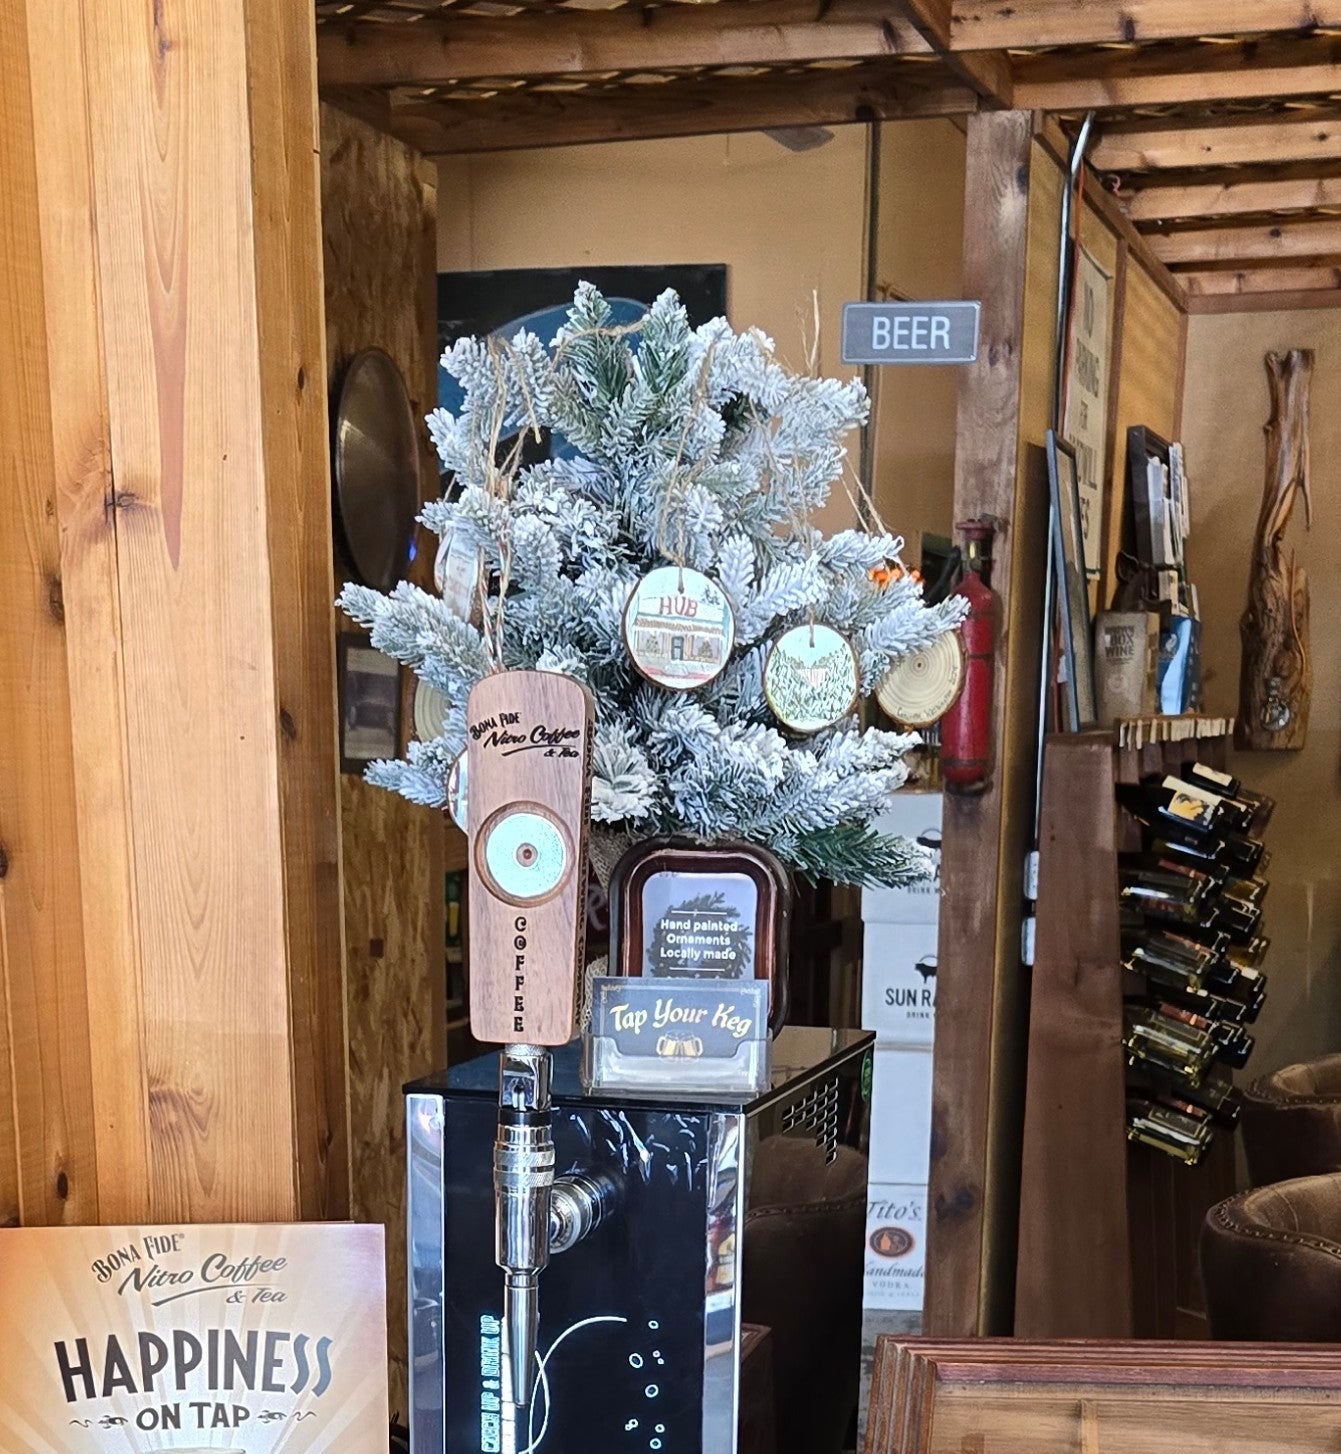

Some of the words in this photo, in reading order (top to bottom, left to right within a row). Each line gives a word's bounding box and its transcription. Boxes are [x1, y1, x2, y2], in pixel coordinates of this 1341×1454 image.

[872, 315, 951, 350] BEER
[659, 595, 698, 618] HUB
[1105, 647, 1134, 657] WINE
[470, 718, 497, 740] BONA
[483, 731, 526, 748] Nitro
[530, 725, 580, 744] Coffee
[544, 749, 554, 757] &
[558, 748, 579, 758] Tea
[661, 919, 690, 931] Hand
[694, 920, 738, 933] painted
[666, 934, 731, 946] Ornaments
[660, 947, 701, 961] Locally
[703, 948, 736, 960] made
[513, 916, 528, 1033] COFFEE
[885, 987, 917, 1007] SUN
[609, 1003, 647, 1035] Tap
[652, 999, 708, 1029] Your
[711, 1003, 752, 1038] Keg
[906, 1011, 930, 1019] DRINK
[868, 1200, 922, 1221] Tito's
[91, 1245, 141, 1283] BONA
[143, 1233, 181, 1260] FIDE
[118, 1264, 193, 1295] Nitro
[200, 1253, 287, 1283] Coffee
[226, 1290, 246, 1303] &
[251, 1288, 287, 1303] Tea
[54, 1329, 333, 1403] HAPPINESS
[136, 1403, 181, 1431] ON
[189, 1402, 250, 1429] TAP
